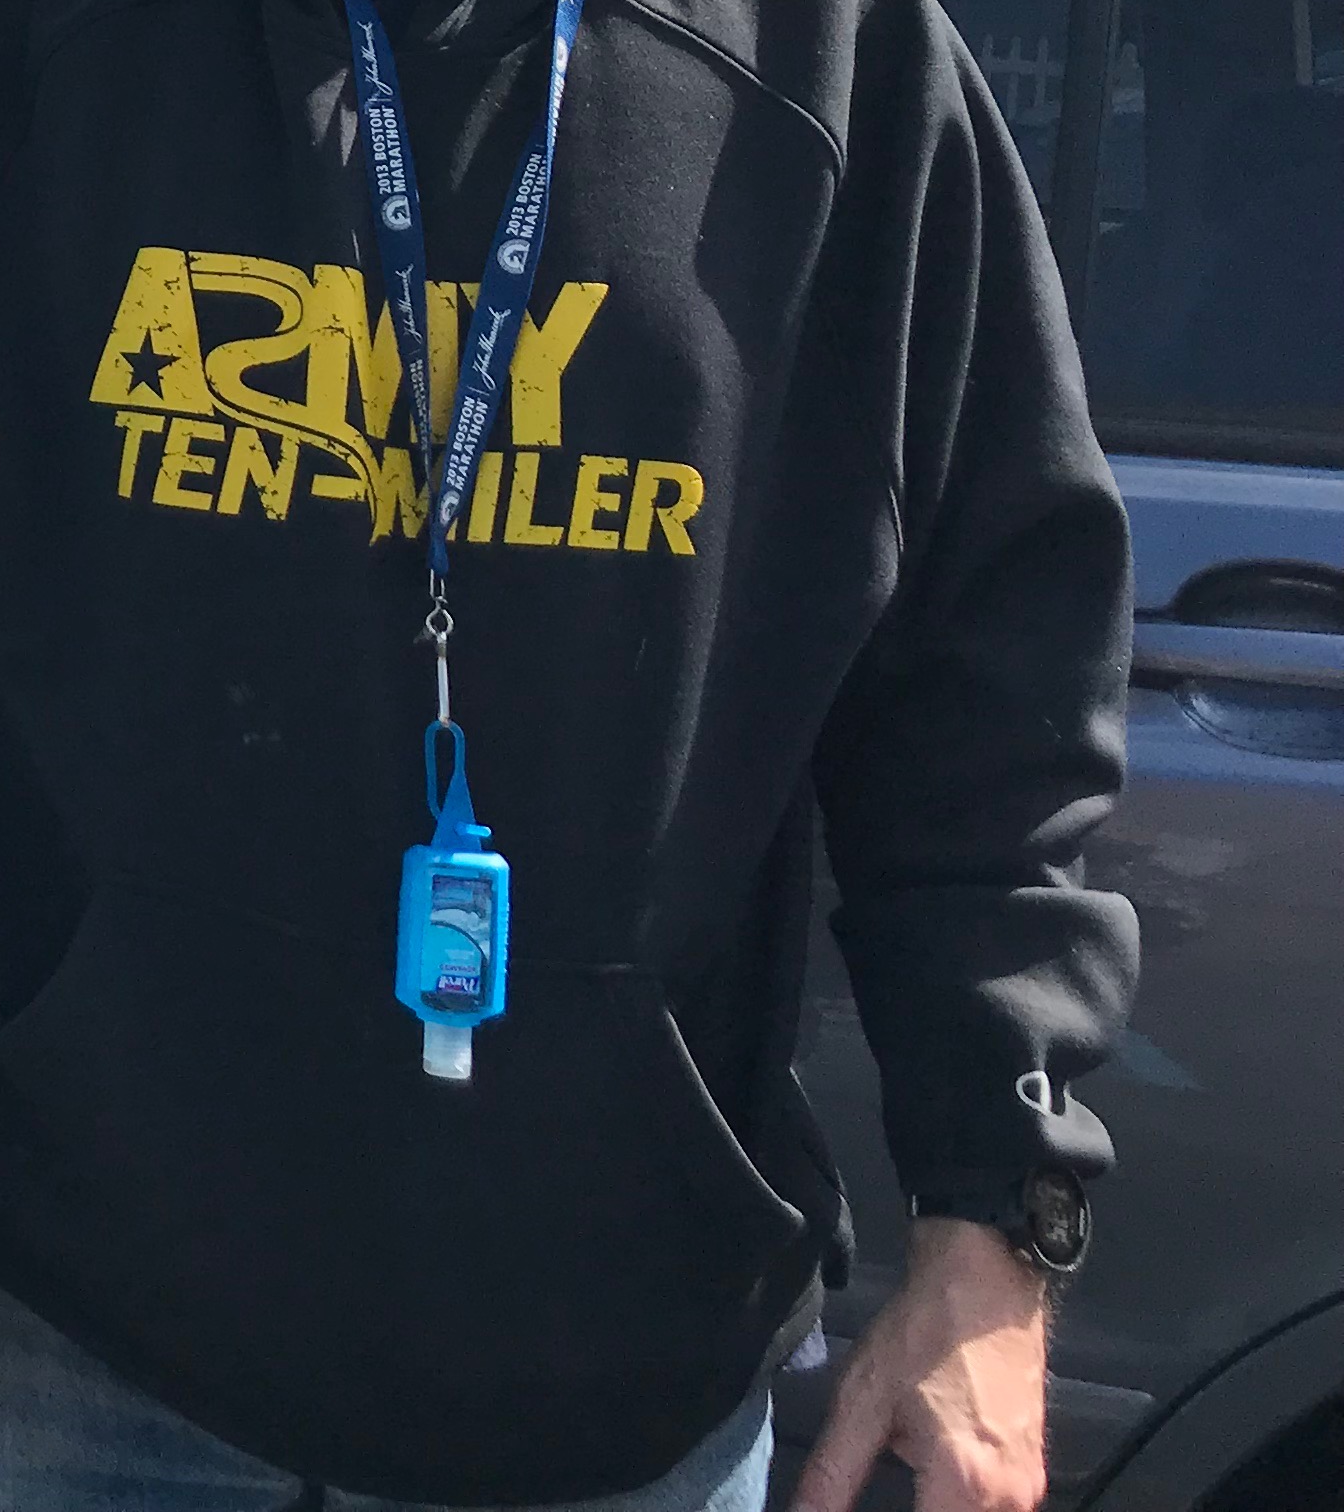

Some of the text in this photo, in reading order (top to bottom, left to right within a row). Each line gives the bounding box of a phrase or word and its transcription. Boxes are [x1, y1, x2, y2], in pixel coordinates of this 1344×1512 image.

[369, 109, 391, 195] 2013 BOSTON
[382, 107, 406, 192] MARATHON
[506, 153, 542, 237] 2013 BOSTON
[520, 155, 547, 238] MARATHO
[446, 396, 475, 485] 2013 BOSTON
[453, 400, 489, 490] MARATHON
